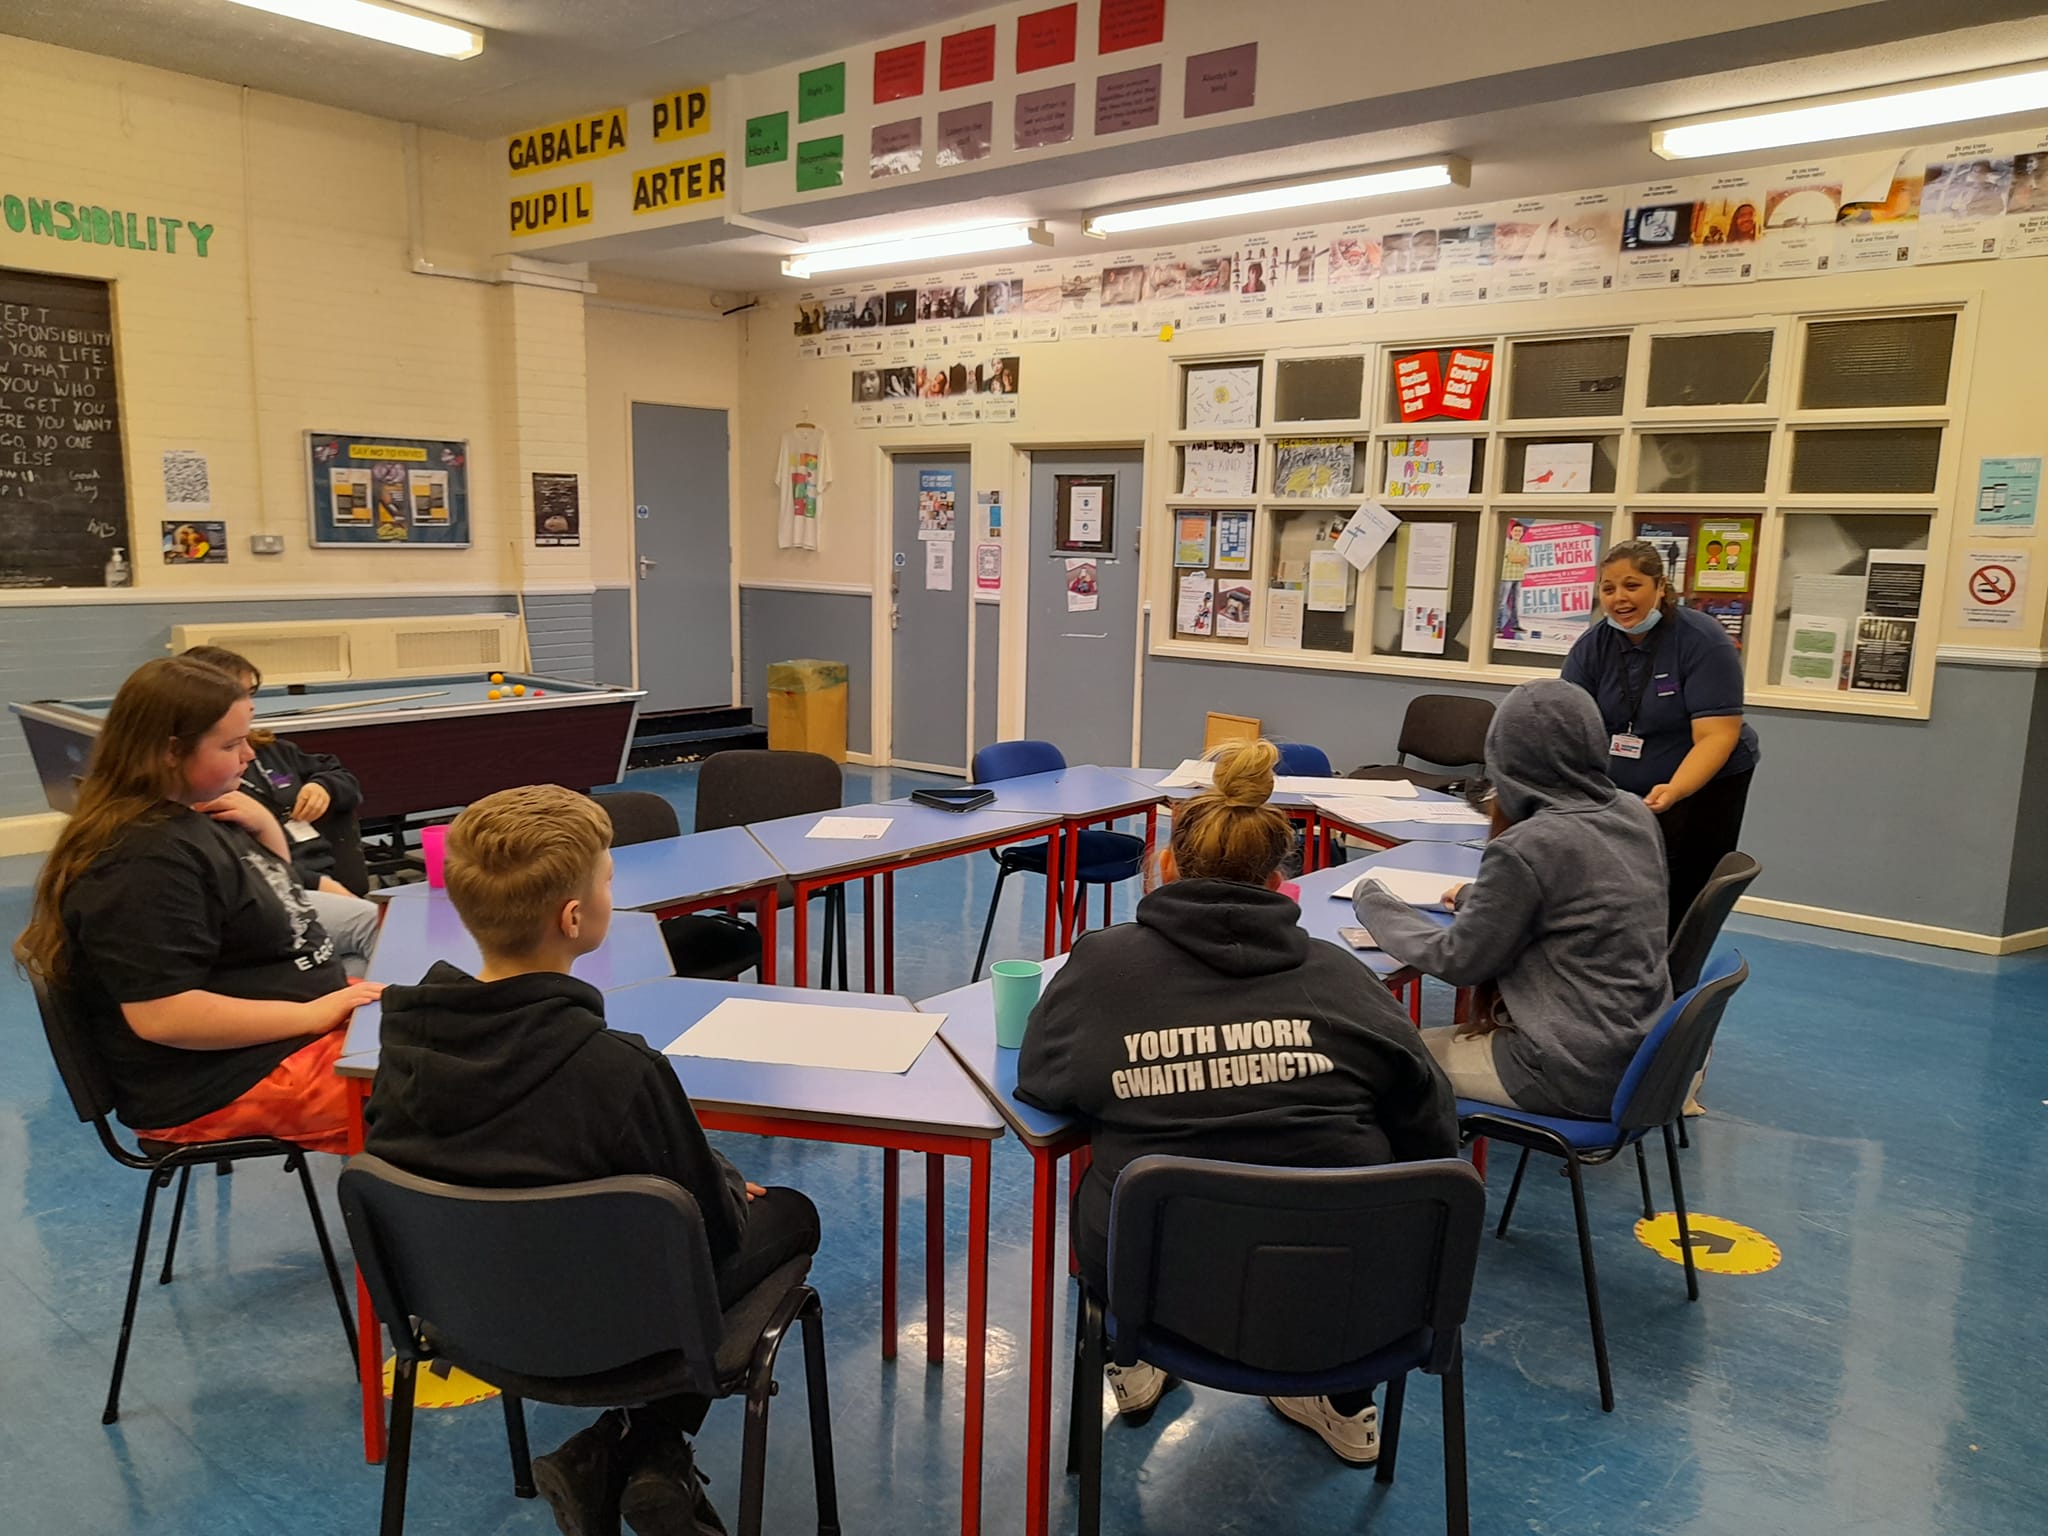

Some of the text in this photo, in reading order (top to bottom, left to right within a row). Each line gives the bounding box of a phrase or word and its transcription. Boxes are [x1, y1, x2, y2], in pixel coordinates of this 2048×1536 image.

[508, 92, 706, 171] GABALFA PIP
[511, 158, 725, 231] PUPIL ARTER
[0, 194, 214, 257] ONSIBILITY
[9, 341, 47, 359] YOUR
[23, 363, 70, 380] THAT
[85, 367, 104, 380] IT
[0, 376, 96, 397] YOU WHO
[24, 397, 62, 412] GET
[73, 400, 105, 416] YOU
[36, 415, 65, 430] YOU
[73, 418, 112, 432] WANT
[37, 435, 58, 450] NO
[65, 435, 93, 449] ONE
[14, 452, 53, 467] ELSE
[1528, 543, 1553, 555] YOUR
[1554, 540, 1580, 552] MAKE
[1529, 549, 1592, 568] LIFE WORK
[1522, 588, 1560, 607] EICH
[1561, 591, 1590, 612] CHI
[1123, 1019, 1313, 1063] YOUTH WORK
[1112, 1061, 1205, 1100] GWAITH
